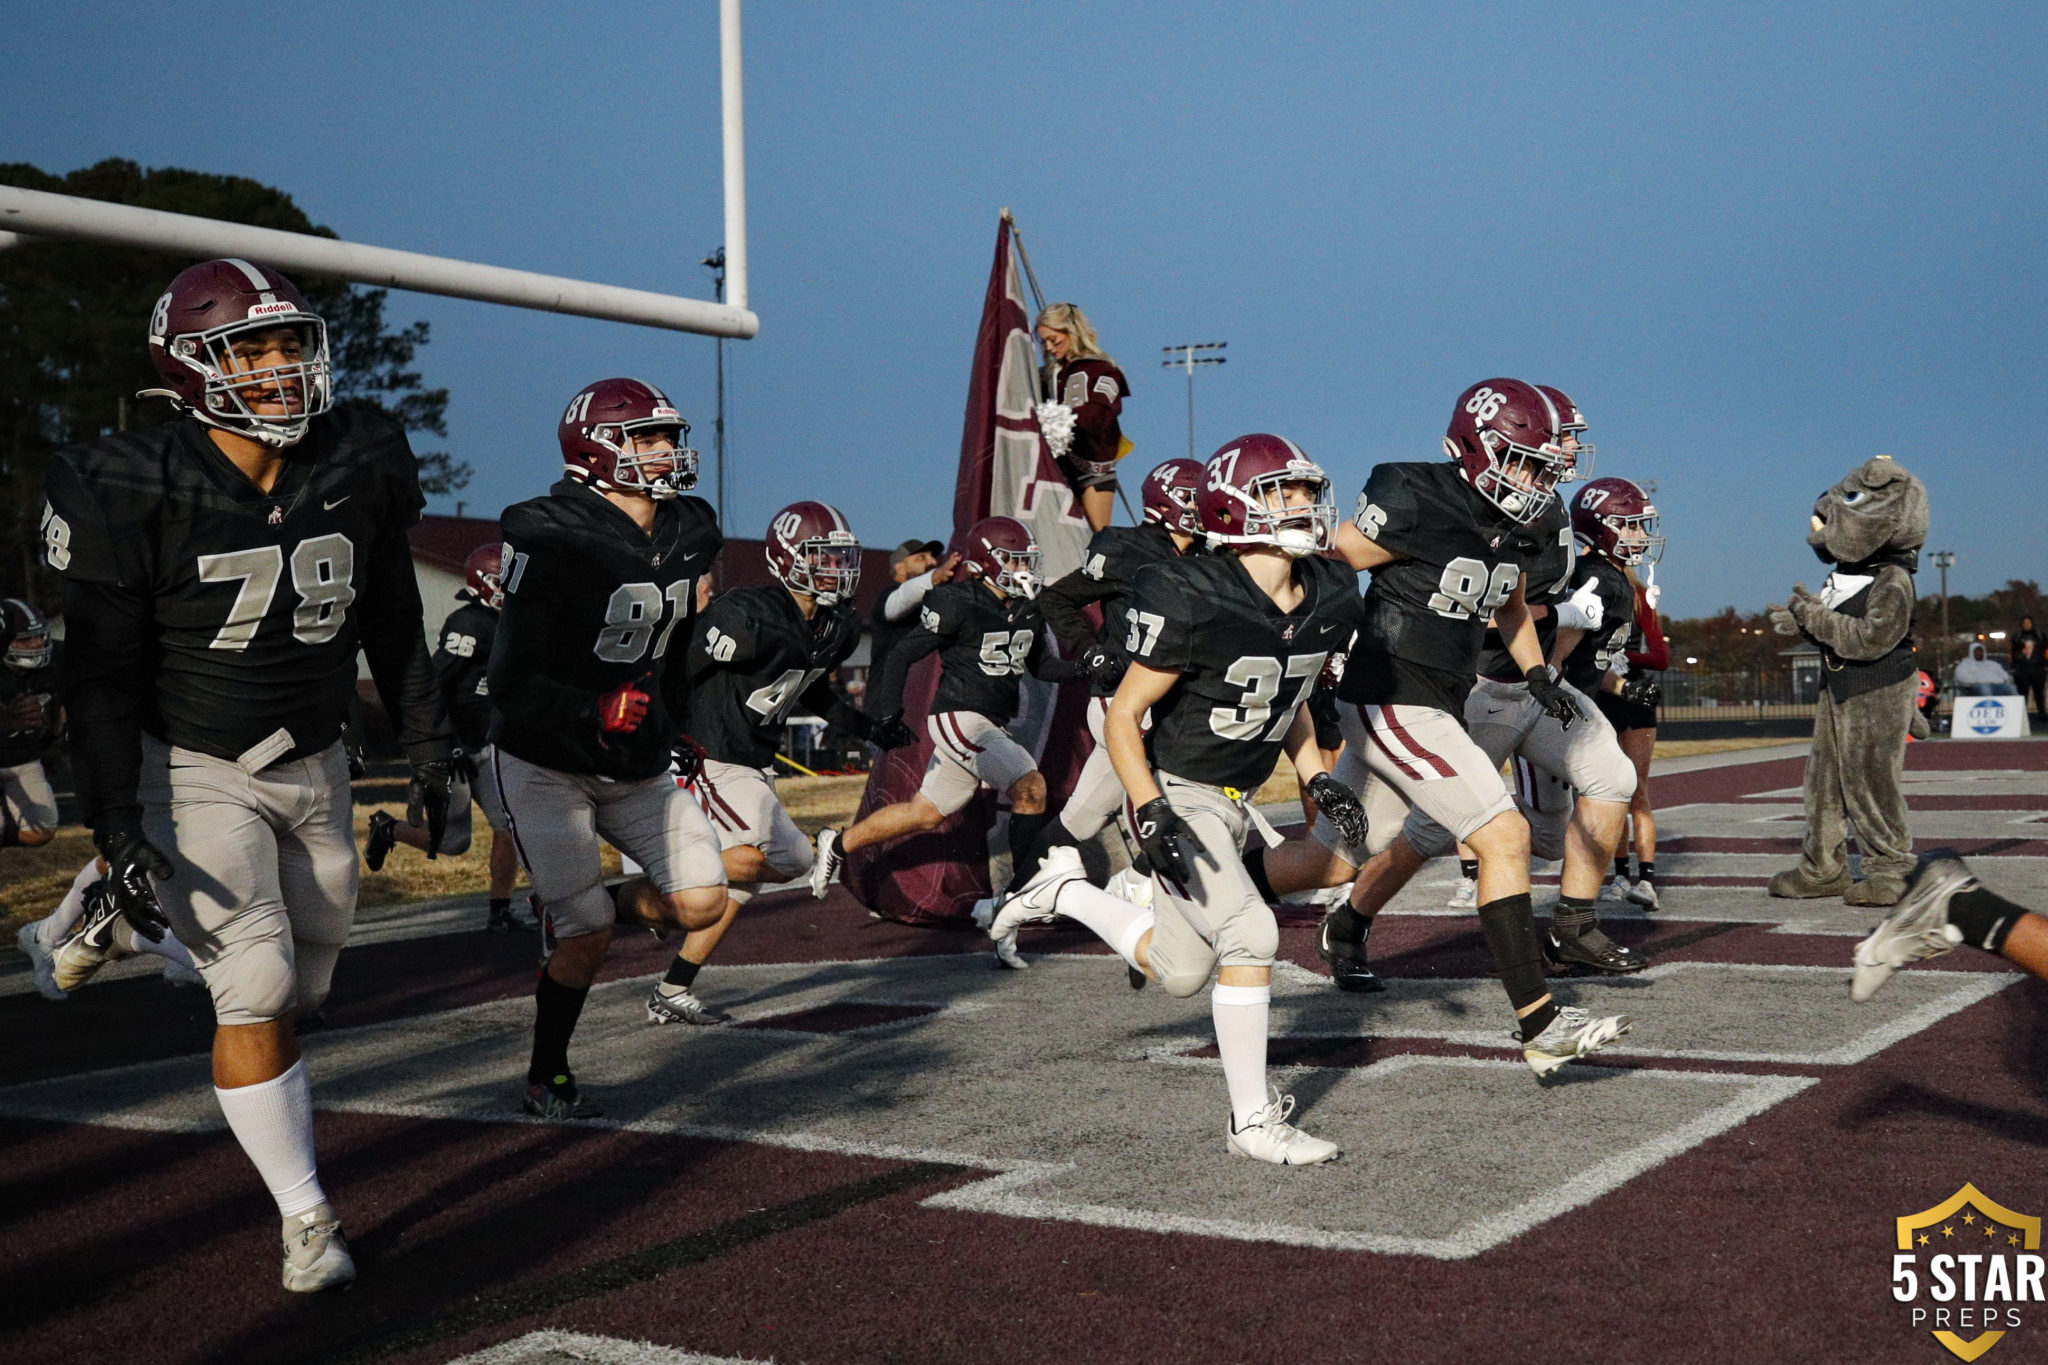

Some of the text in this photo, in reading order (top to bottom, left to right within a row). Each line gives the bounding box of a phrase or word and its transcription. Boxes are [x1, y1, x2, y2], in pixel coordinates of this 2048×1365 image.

[148, 292, 173, 336] 8
[255, 303, 293, 314] Riddell
[1063, 370, 1089, 407] B
[1464, 386, 1508, 422] 86
[565, 391, 595, 425] 81
[1152, 463, 1181, 485] 44
[1206, 447, 1242, 493] 37
[1579, 488, 1611, 511] 87
[773, 511, 802, 539] 40
[197, 531, 356, 652] 78
[593, 578, 690, 664] 81
[1125, 607, 1165, 657] 37
[444, 631, 477, 658] 26
[1208, 650, 1330, 742] 37
